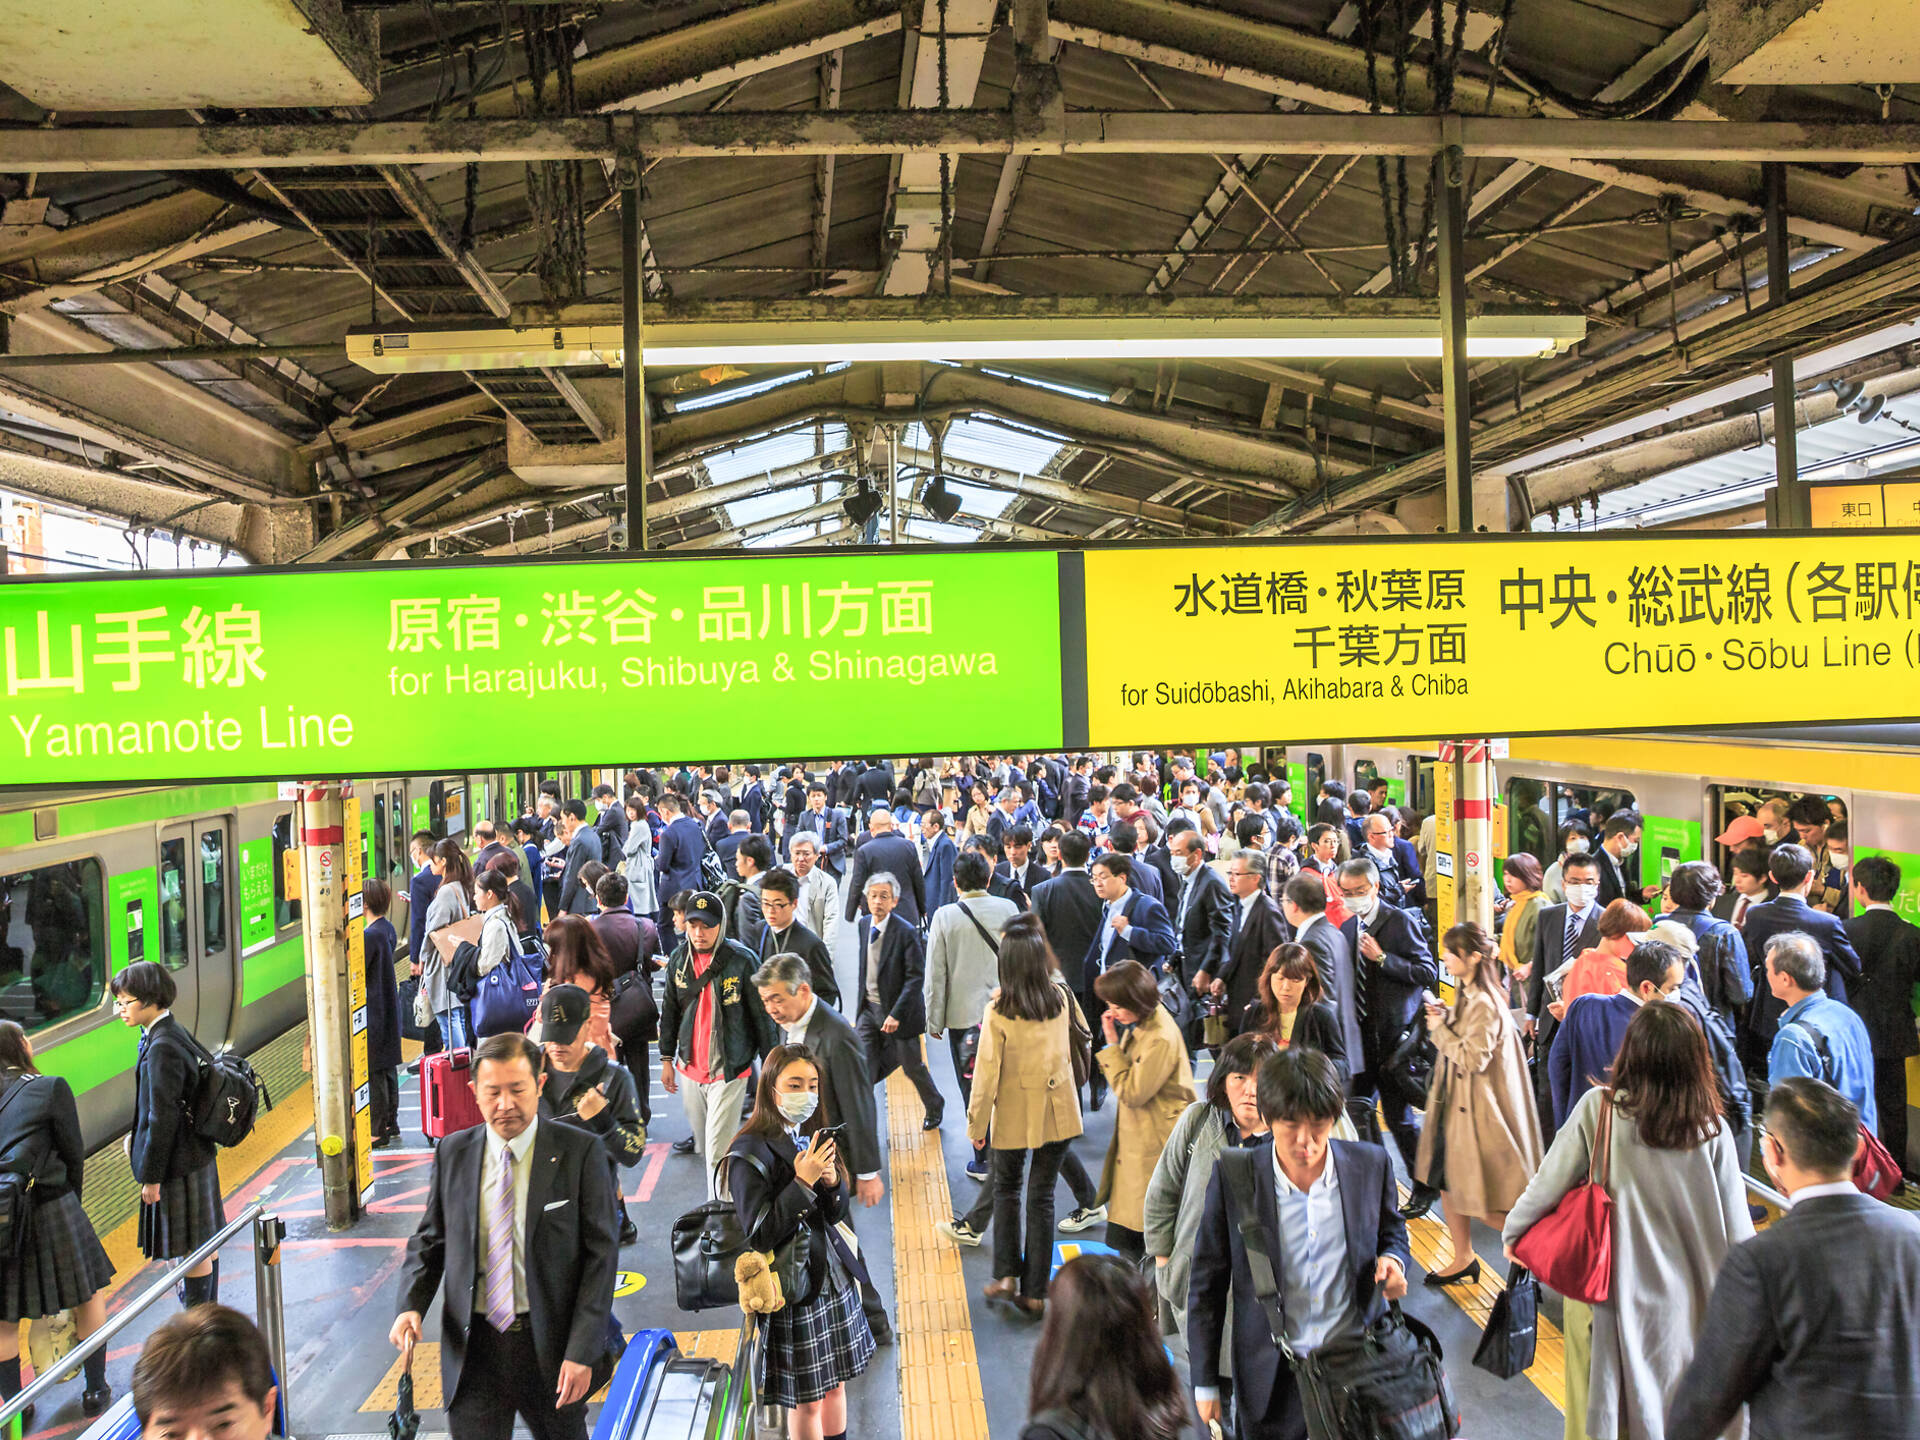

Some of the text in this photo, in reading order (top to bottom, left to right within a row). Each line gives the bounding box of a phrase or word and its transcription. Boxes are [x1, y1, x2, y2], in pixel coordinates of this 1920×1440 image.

[1841, 502, 1871, 517] 東口
[386, 580, 934, 653] 原宿・渋谷・品川方面
[1173, 568, 1467, 617] 水道橋・秋葉原
[4, 603, 268, 697] 山手線
[1293, 622, 1468, 669] 千葉方面
[1823, 635, 1892, 667] Line
[387, 648, 1000, 699] for Harajuku, Shibuya & Shinagawa
[1121, 672, 1469, 706] for Suidōbashi, Akihabara & Chiba
[9, 704, 355, 758] Yamanote Line
